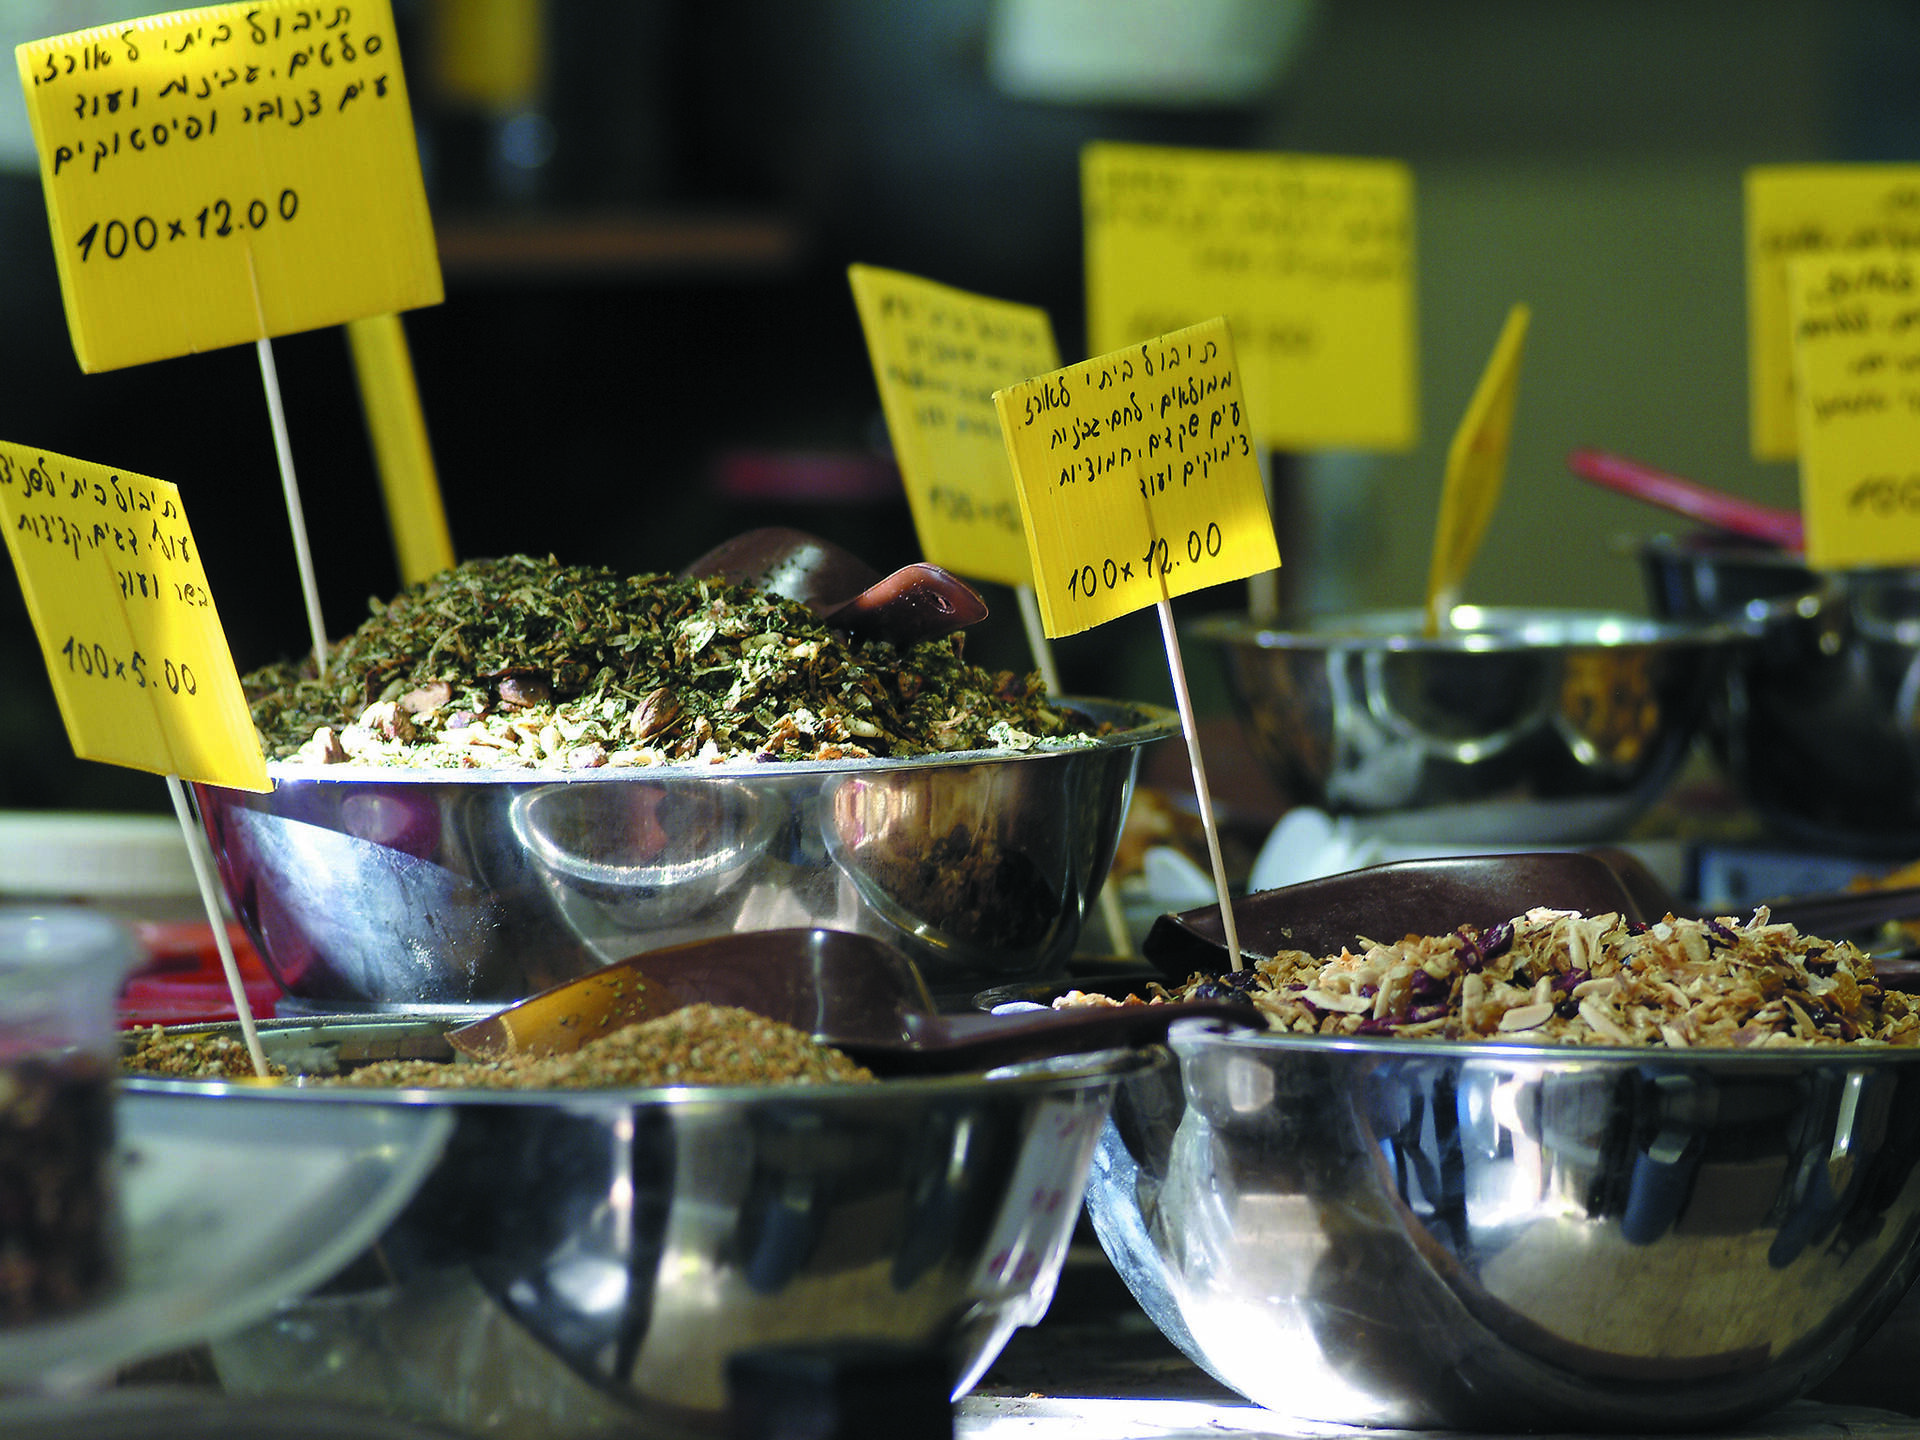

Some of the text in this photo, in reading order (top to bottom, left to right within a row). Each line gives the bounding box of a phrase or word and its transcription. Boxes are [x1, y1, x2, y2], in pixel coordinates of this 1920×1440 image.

[163, 24, 232, 54] ביתי
[246, 7, 352, 46] תיבול
[53, 109, 218, 176] ופיסטוקים
[1085, 360, 1134, 390] ביתי
[1143, 341, 1217, 377] תיבול
[1209, 401, 1240, 440] עים
[110, 474, 177, 520] תיבול
[1139, 463, 1173, 500] ועוד
